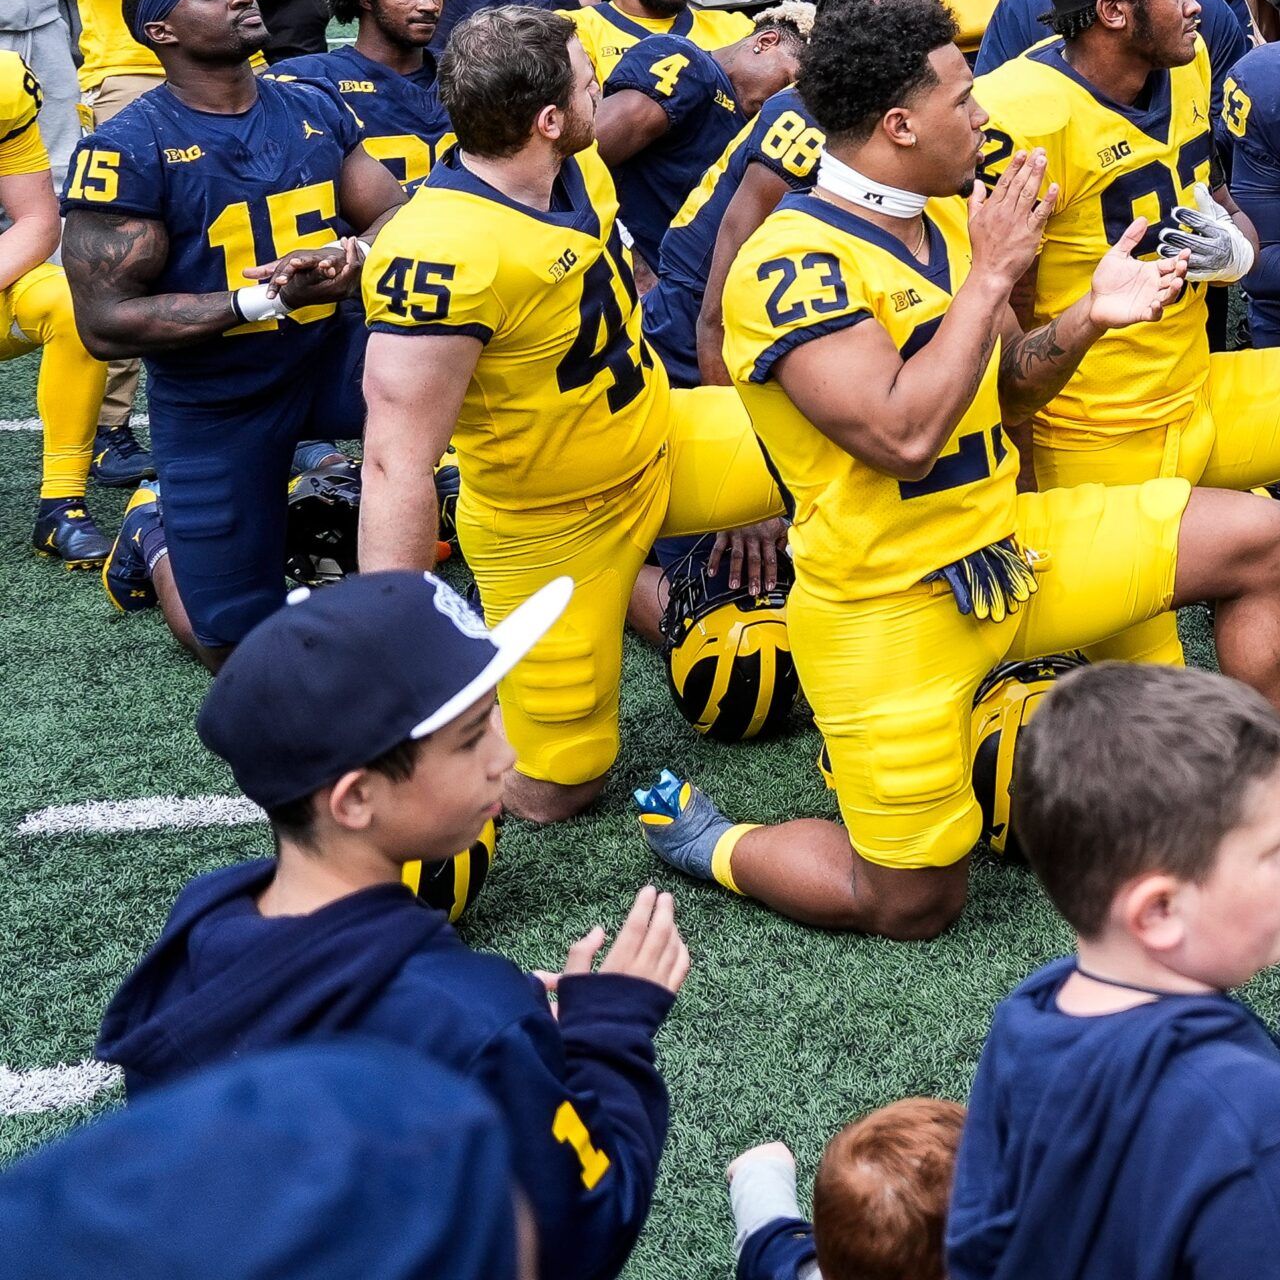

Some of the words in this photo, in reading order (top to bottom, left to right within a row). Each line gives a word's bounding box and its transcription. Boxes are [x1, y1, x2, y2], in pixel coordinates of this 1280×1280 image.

[649, 52, 691, 97] 4
[67, 149, 121, 203] 15
[759, 110, 827, 178] 88
[207, 180, 339, 337] 15
[376, 256, 457, 322] 45
[756, 252, 851, 329] 23
[551, 1099, 611, 1191] 1
